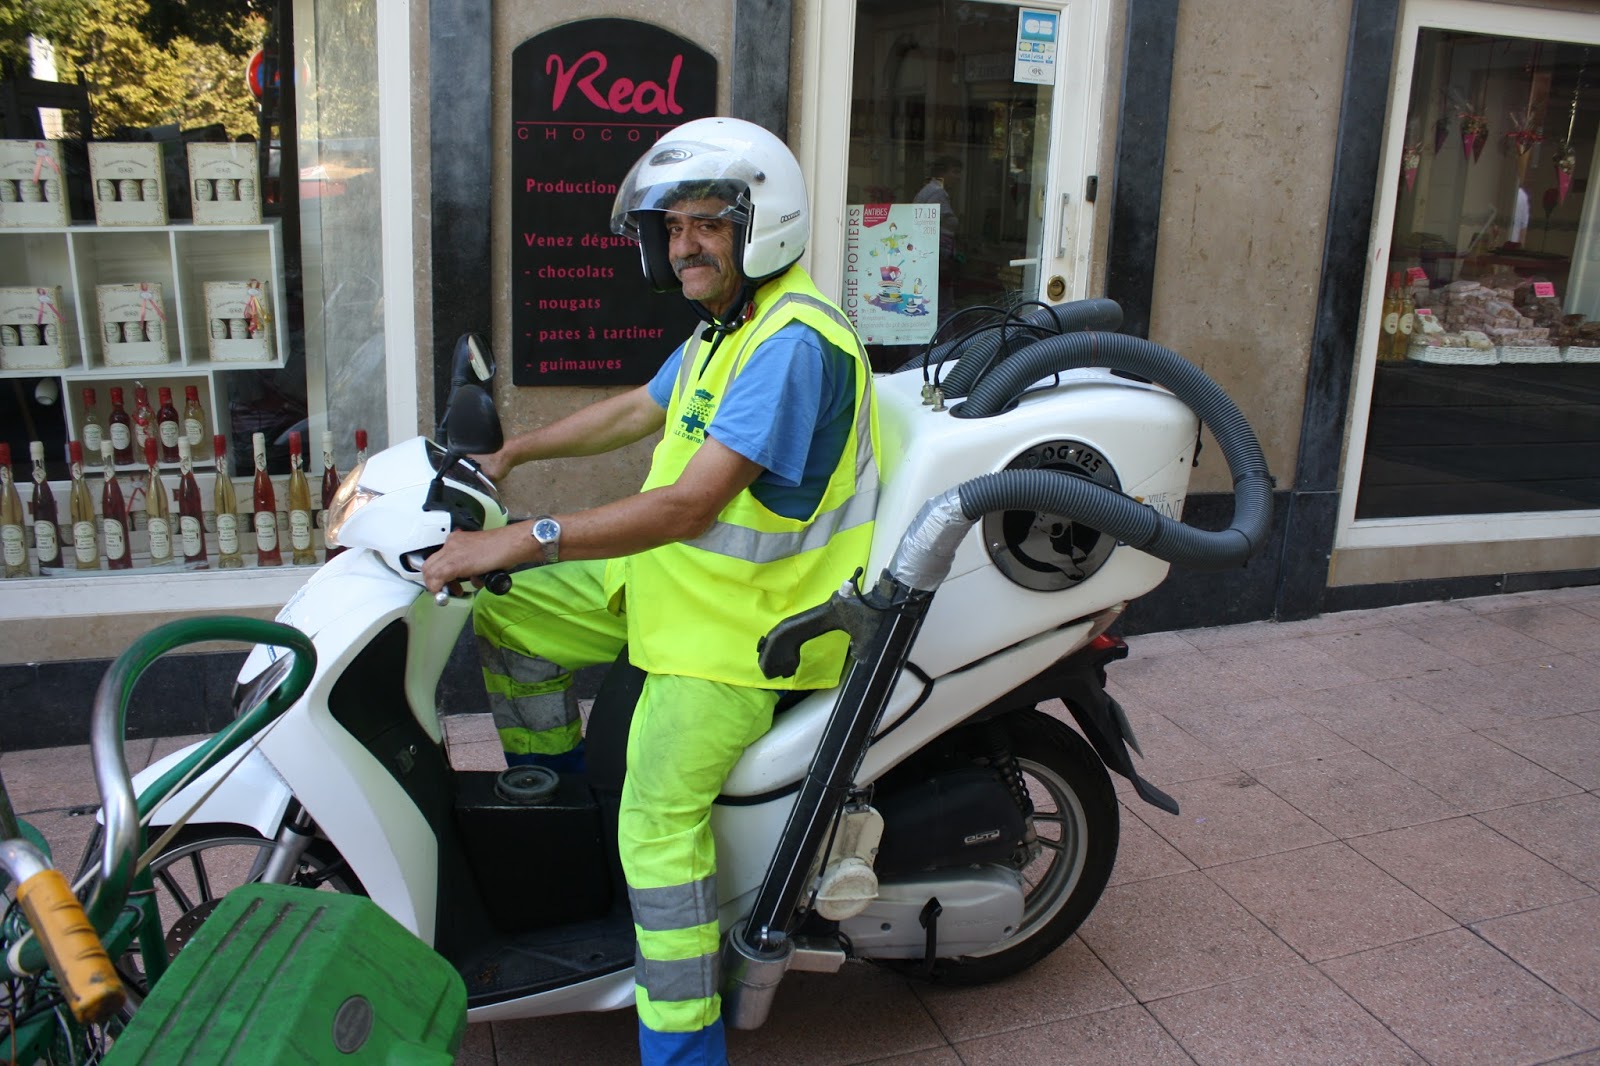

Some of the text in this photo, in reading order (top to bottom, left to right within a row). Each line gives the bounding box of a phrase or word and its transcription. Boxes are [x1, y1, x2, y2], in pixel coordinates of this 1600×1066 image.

[545, 50, 684, 116] Real
[517, 127, 660, 142] CHOCOL
[526, 178, 617, 194] Production
[864, 208, 888, 216] ANTIBES
[914, 208, 937, 219] 17 18
[524, 233, 574, 247] Venez
[538, 264, 615, 279] chocolats
[844, 208, 860, 329] ARCHÉ POTIERS
[538, 297, 601, 312] nougats
[539, 328, 581, 343] pates
[587, 326, 596, 340] à
[603, 325, 664, 340] tartiner
[539, 358, 622, 374] guimauves
[1076, 449, 1102, 473] 125
